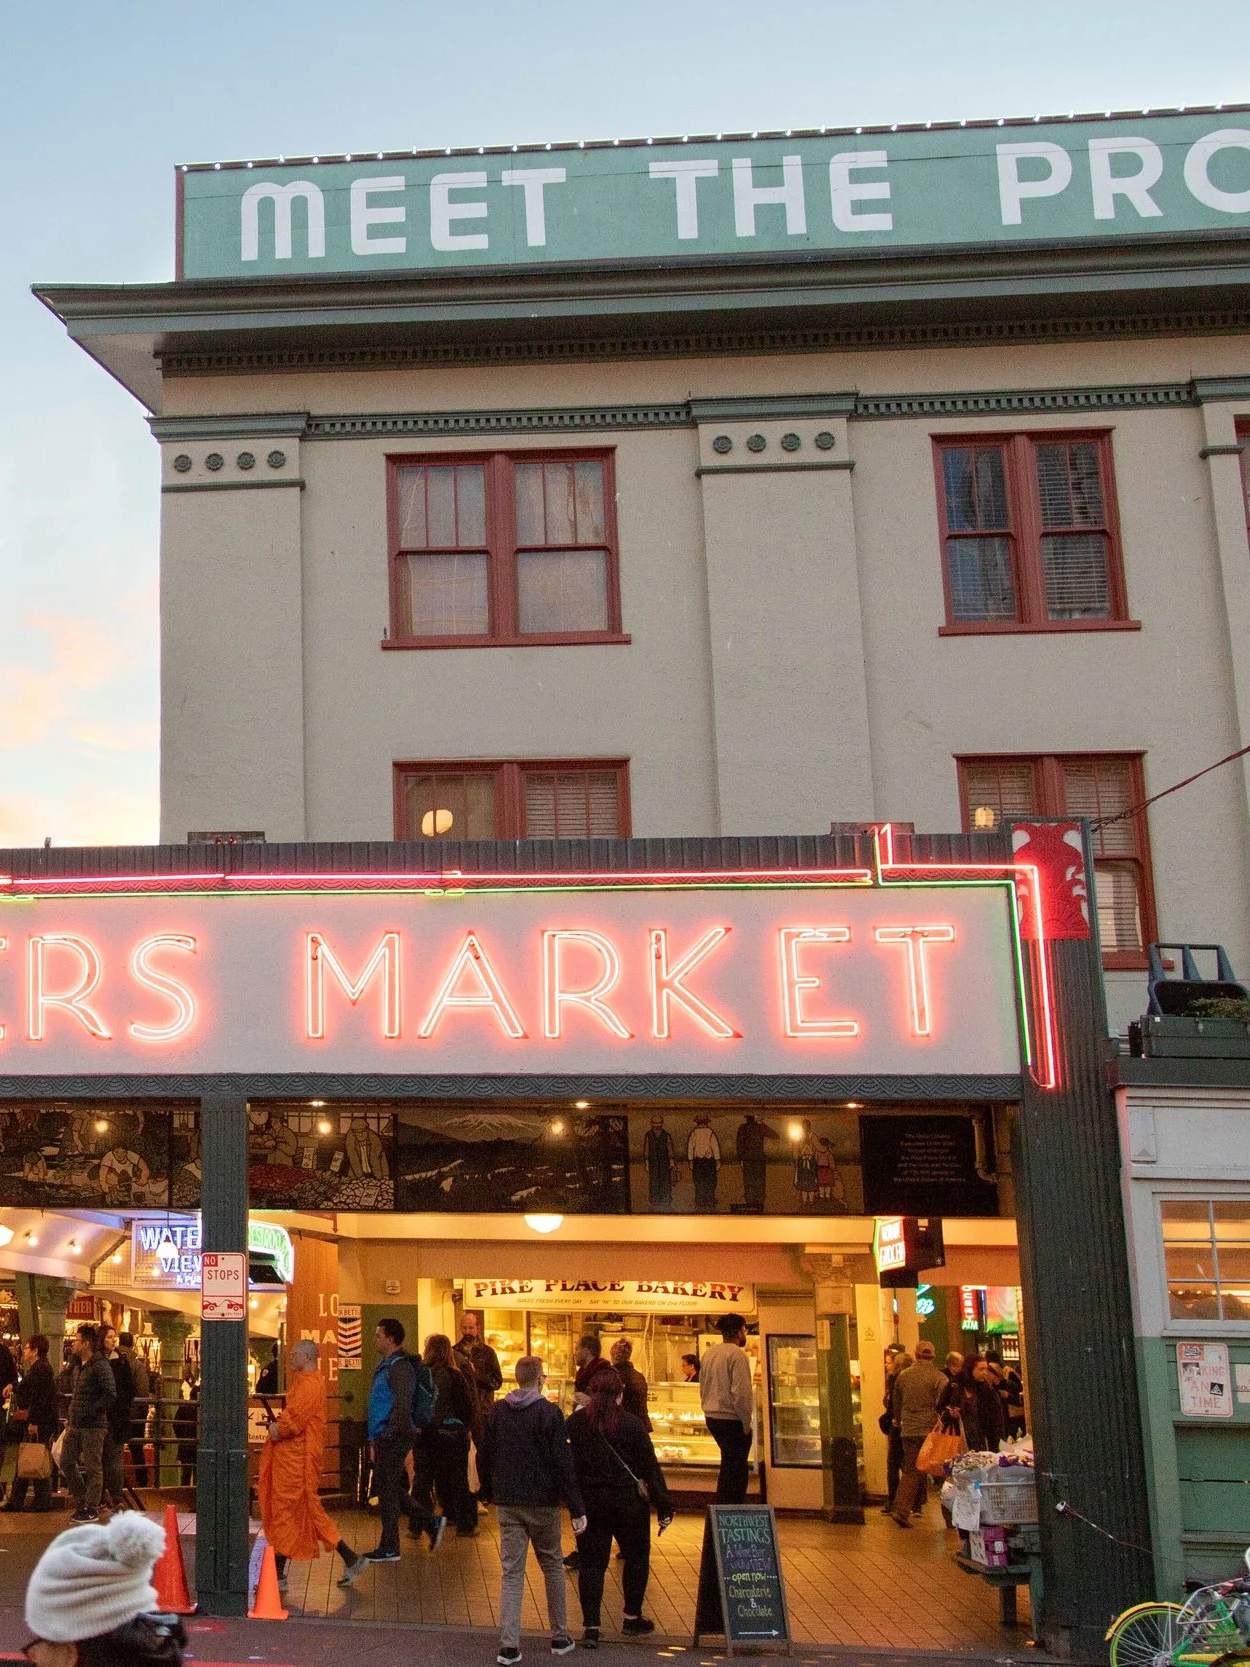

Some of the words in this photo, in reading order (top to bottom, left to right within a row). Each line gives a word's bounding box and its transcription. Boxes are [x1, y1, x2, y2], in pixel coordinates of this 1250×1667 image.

[240, 168, 566, 262] MEET
[649, 150, 893, 241] THE
[996, 126, 1250, 227] PRO
[305, 925, 959, 1039] MARKET
[204, 1256, 217, 1266] NO
[207, 1269, 239, 1281] STOPS
[474, 1279, 534, 1298] PIKE
[545, 1280, 625, 1292] PLACE
[636, 1280, 744, 1302] BAKERY
[961, 1320, 979, 1330] ATM
[1190, 1396, 1222, 1409] TIME
[718, 1515, 769, 1528] NORTHWEST
[718, 1528, 771, 1544] TASTINGS
[732, 1572, 750, 1585] open
[751, 1572, 767, 1582] now
[750, 1598, 757, 1608] &
[737, 1604, 773, 1617] Chocolate
